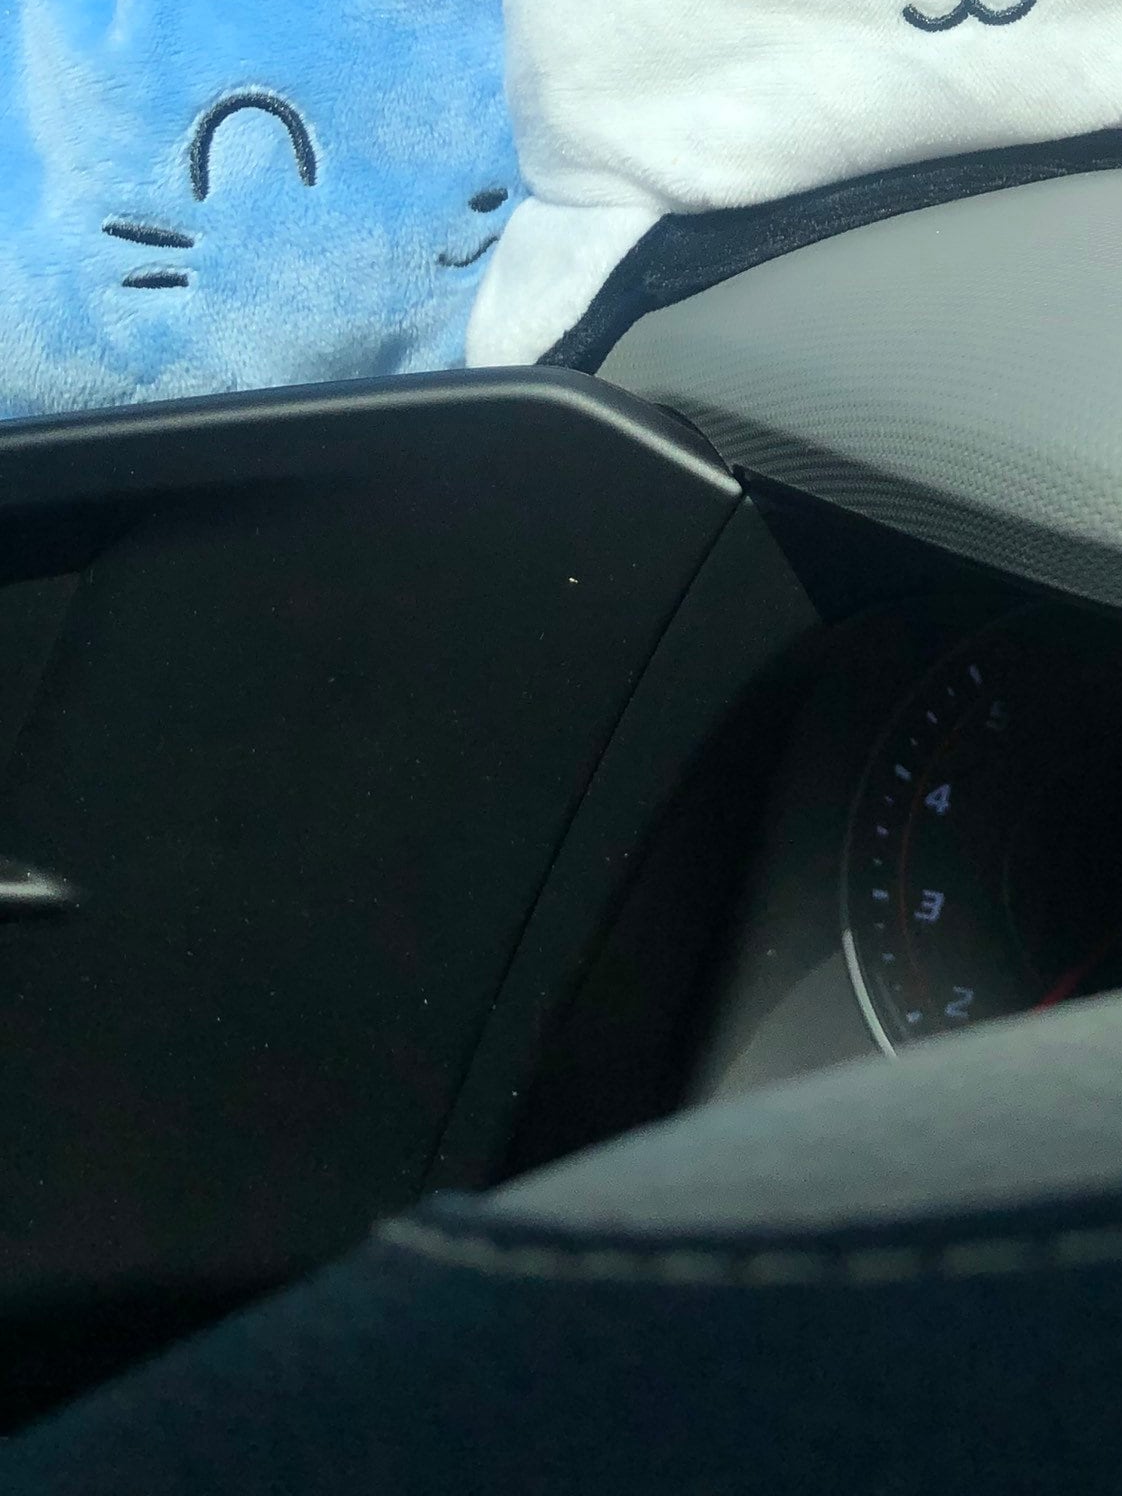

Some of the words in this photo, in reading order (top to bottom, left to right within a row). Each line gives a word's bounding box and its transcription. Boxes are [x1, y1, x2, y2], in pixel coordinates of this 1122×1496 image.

[923, 784, 952, 816] 4
[914, 890, 946, 922] 3
[944, 986, 975, 1019] 2
